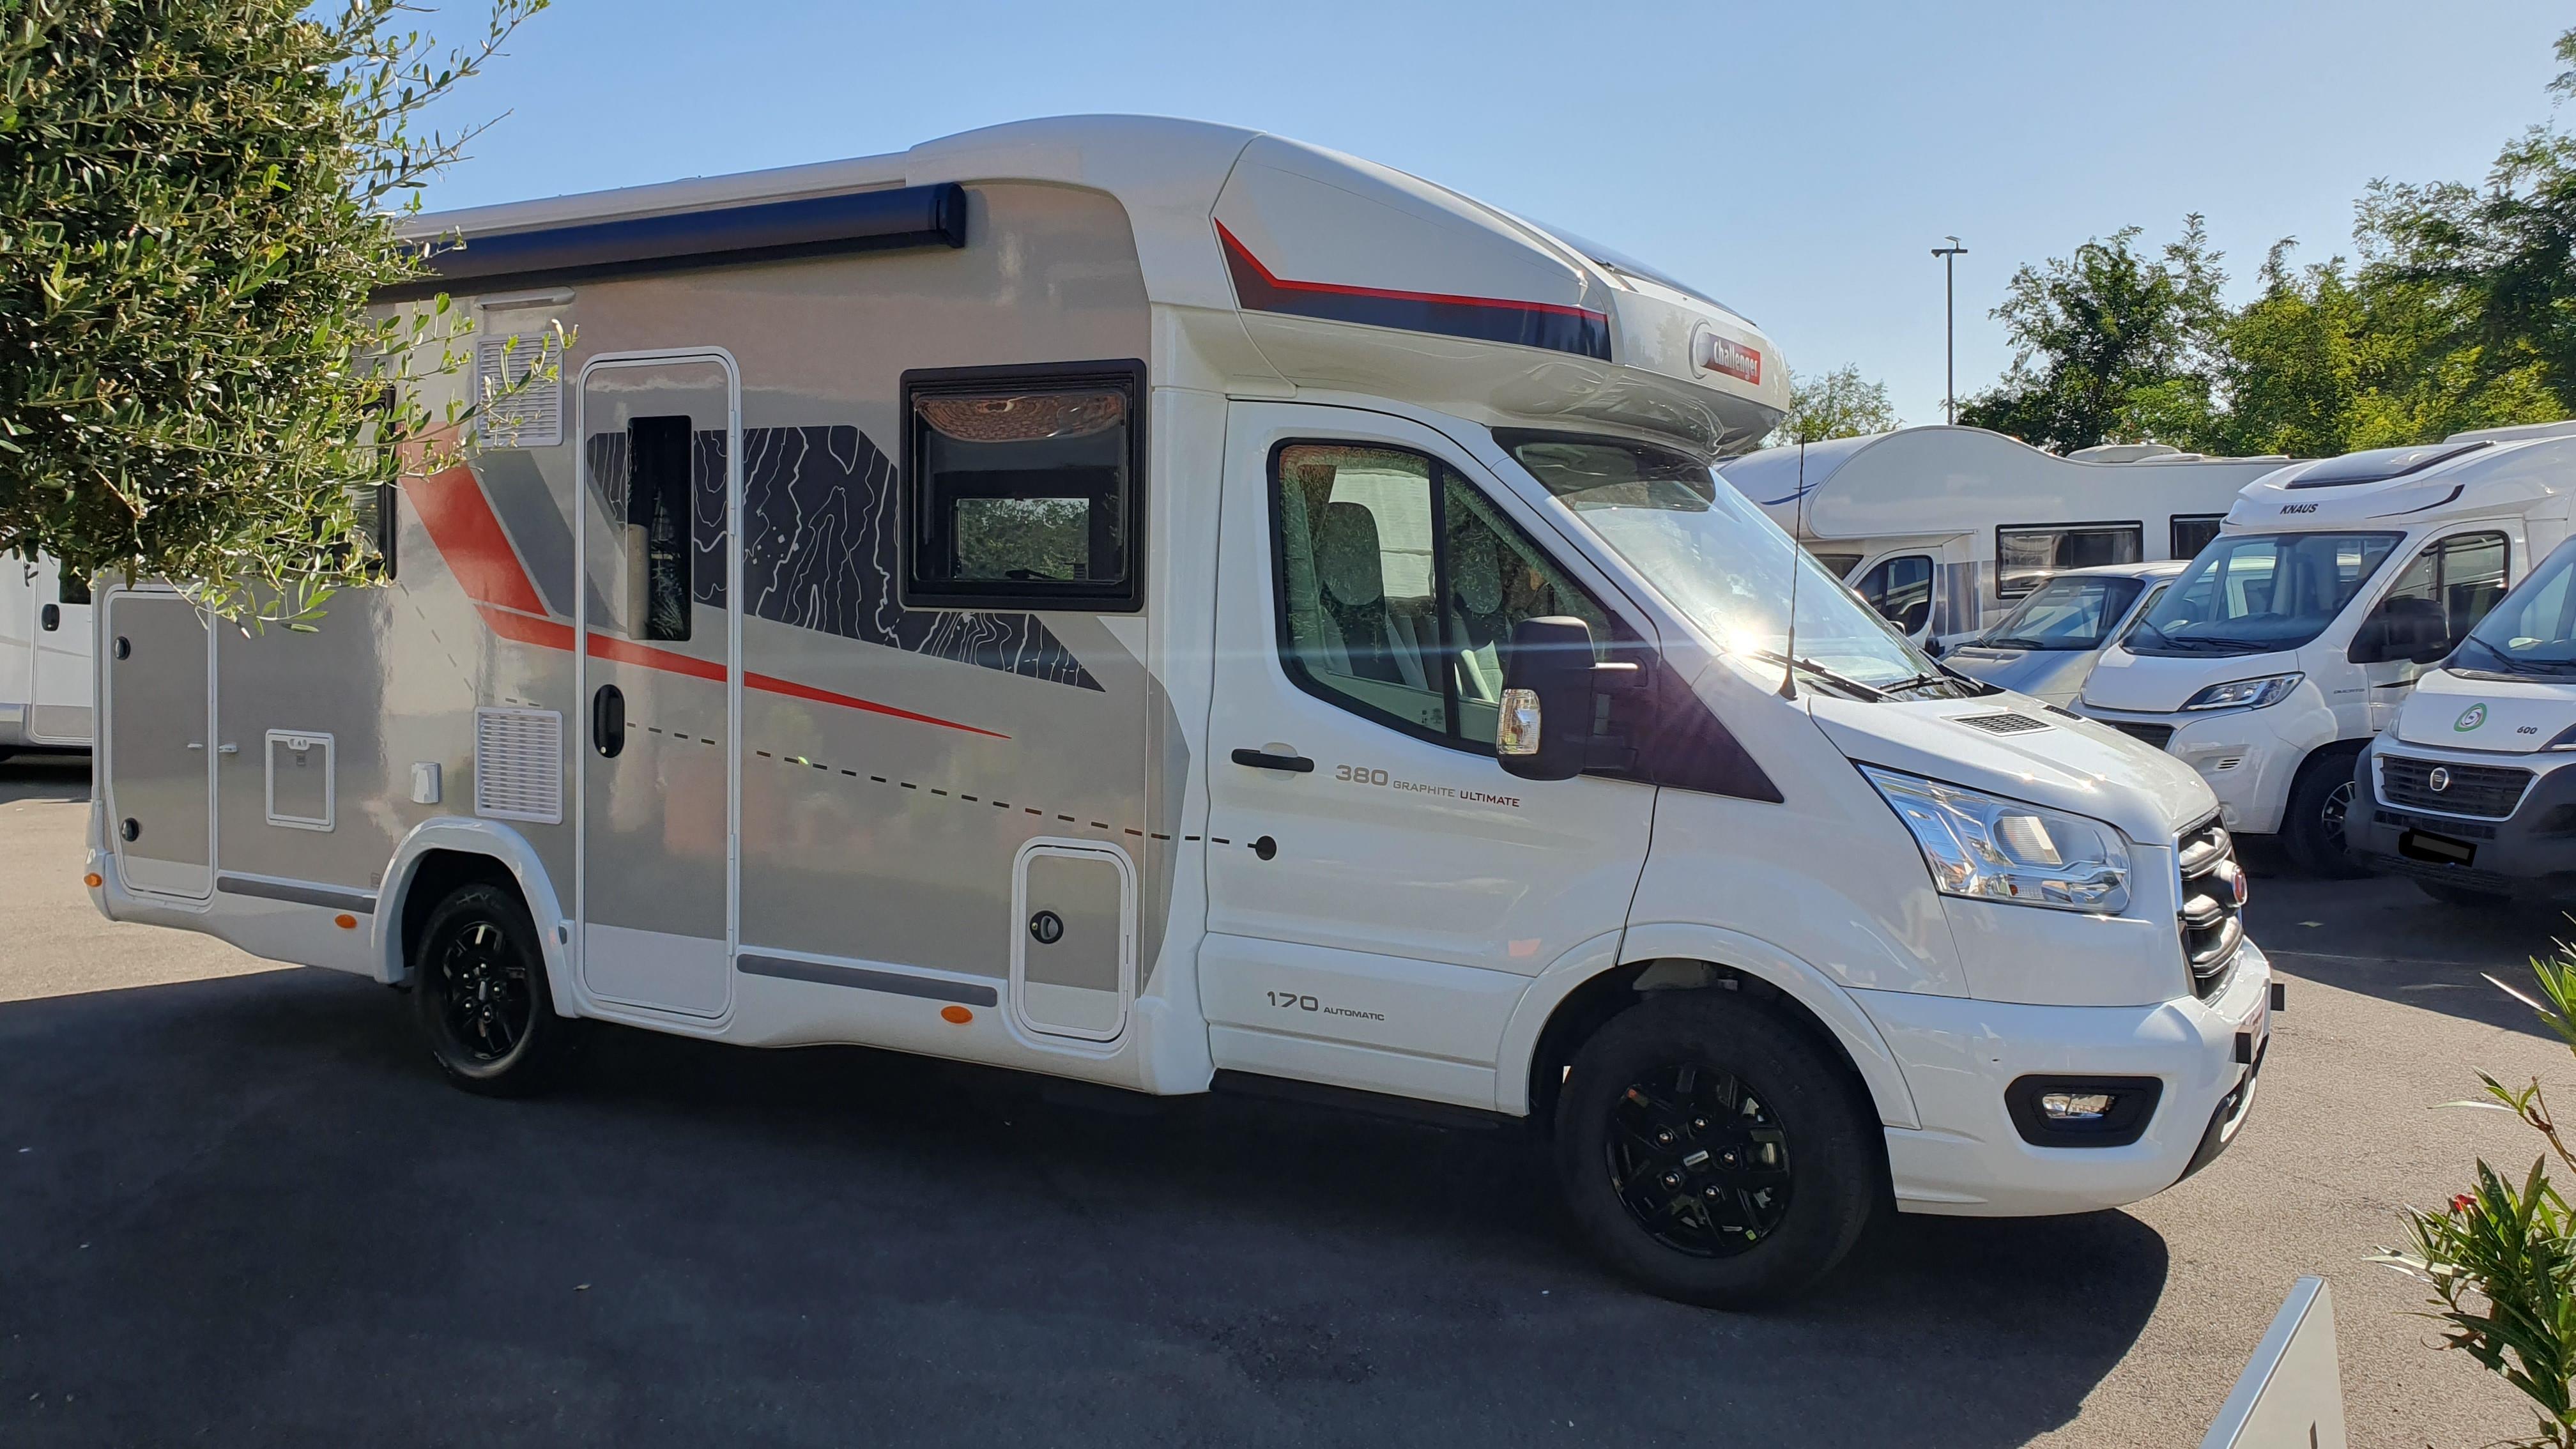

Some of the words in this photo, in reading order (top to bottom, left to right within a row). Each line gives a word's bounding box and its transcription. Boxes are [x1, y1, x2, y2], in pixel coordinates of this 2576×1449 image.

[1713, 339, 1758, 381] Challenger
[2280, 503, 2319, 515] KNAUS
[2517, 726, 2538, 735] 600
[1335, 764, 1389, 786] 380
[1393, 780, 1456, 798] GRAPHITE
[1459, 790, 1521, 808] ULTIMATE
[1267, 991, 1319, 1012] 170
[1323, 1006, 1385, 1022] AUTOMATIC
